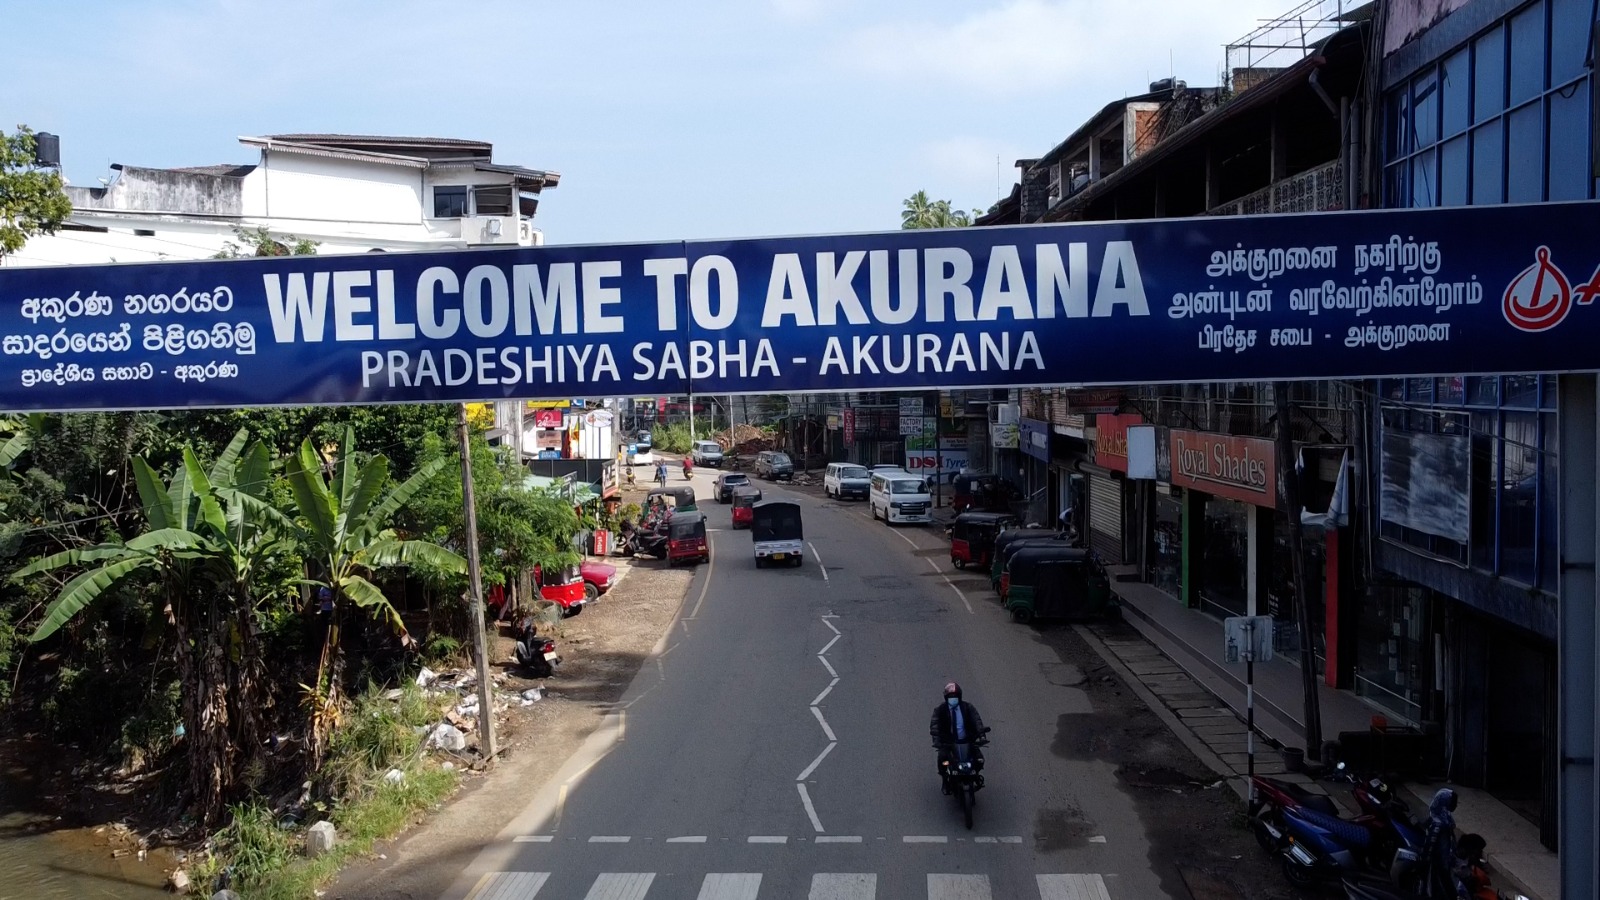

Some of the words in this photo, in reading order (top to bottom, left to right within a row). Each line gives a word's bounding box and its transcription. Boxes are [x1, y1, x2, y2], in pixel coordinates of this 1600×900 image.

[1354, 234, 1442, 275] நகரிற்கு
[20, 290, 113, 324] අකුරණ
[123, 285, 234, 315] නගරයට
[262, 261, 625, 343] WELCOME
[643, 254, 740, 332] TO
[760, 239, 1150, 328] AKURANA
[1167, 282, 1273, 321] அன்புடன்
[1289, 274, 1483, 317] வரவேற்கின்றோம்
[1, 323, 132, 360] සාදරයෙන්
[142, 321, 256, 355] පිළිගනිමු
[1198, 323, 1257, 354] பிரதேச
[1270, 327, 1312, 347] சபை
[101, 361, 154, 382] සභාව
[174, 360, 239, 383] අකුරණ
[361, 344, 622, 389] PRADESHIYA
[632, 338, 782, 382] SABHA
[818, 330, 1046, 376] AKURANA
[900, 418, 922, 426] FACTORY
[900, 425, 918, 434] OUTLET
[1115, 430, 1128, 459] Sha
[1177, 438, 1210, 482] Royal
[1214, 441, 1267, 487] Shades
